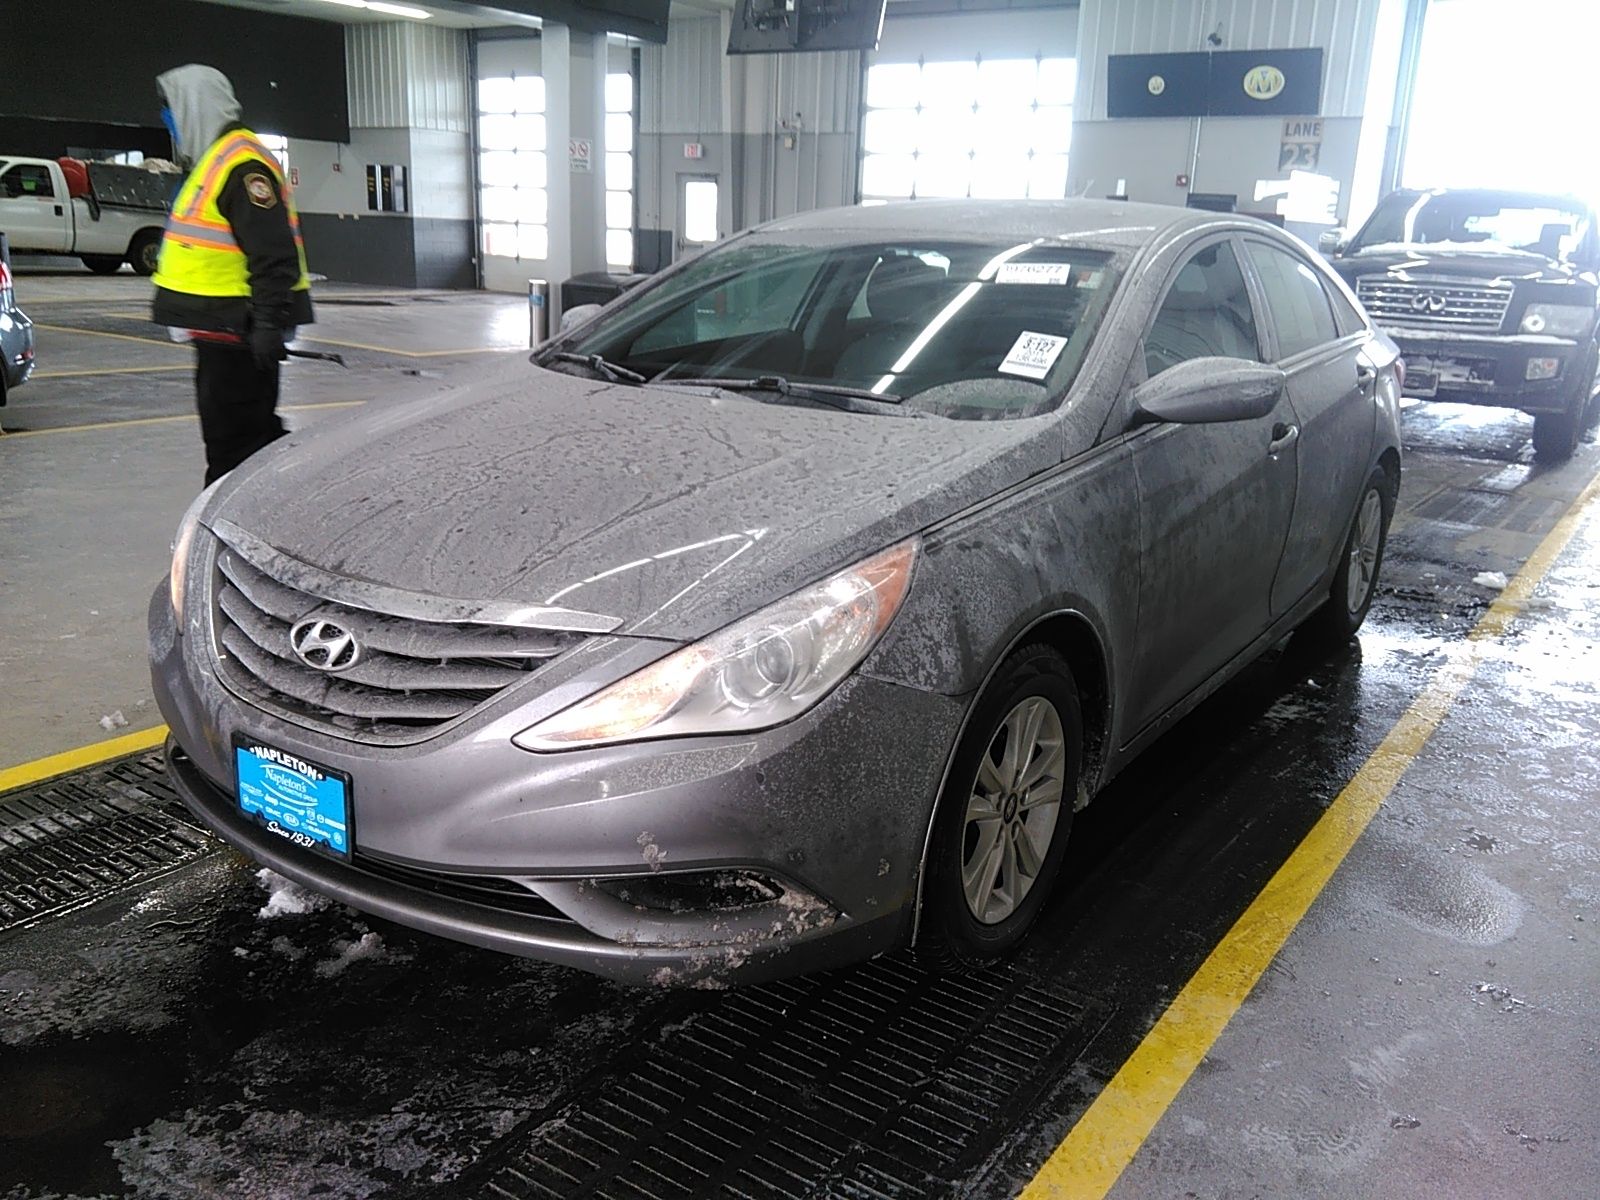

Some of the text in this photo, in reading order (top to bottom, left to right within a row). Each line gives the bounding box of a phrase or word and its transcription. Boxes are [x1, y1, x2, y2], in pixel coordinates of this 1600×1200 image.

[1285, 122, 1321, 137] LANE
[1282, 143, 1316, 169] 23
[254, 746, 317, 781] NAPLETON
[265, 767, 307, 793] Napleton's
[266, 821, 290, 838] Since
[290, 831, 315, 848] 1931
